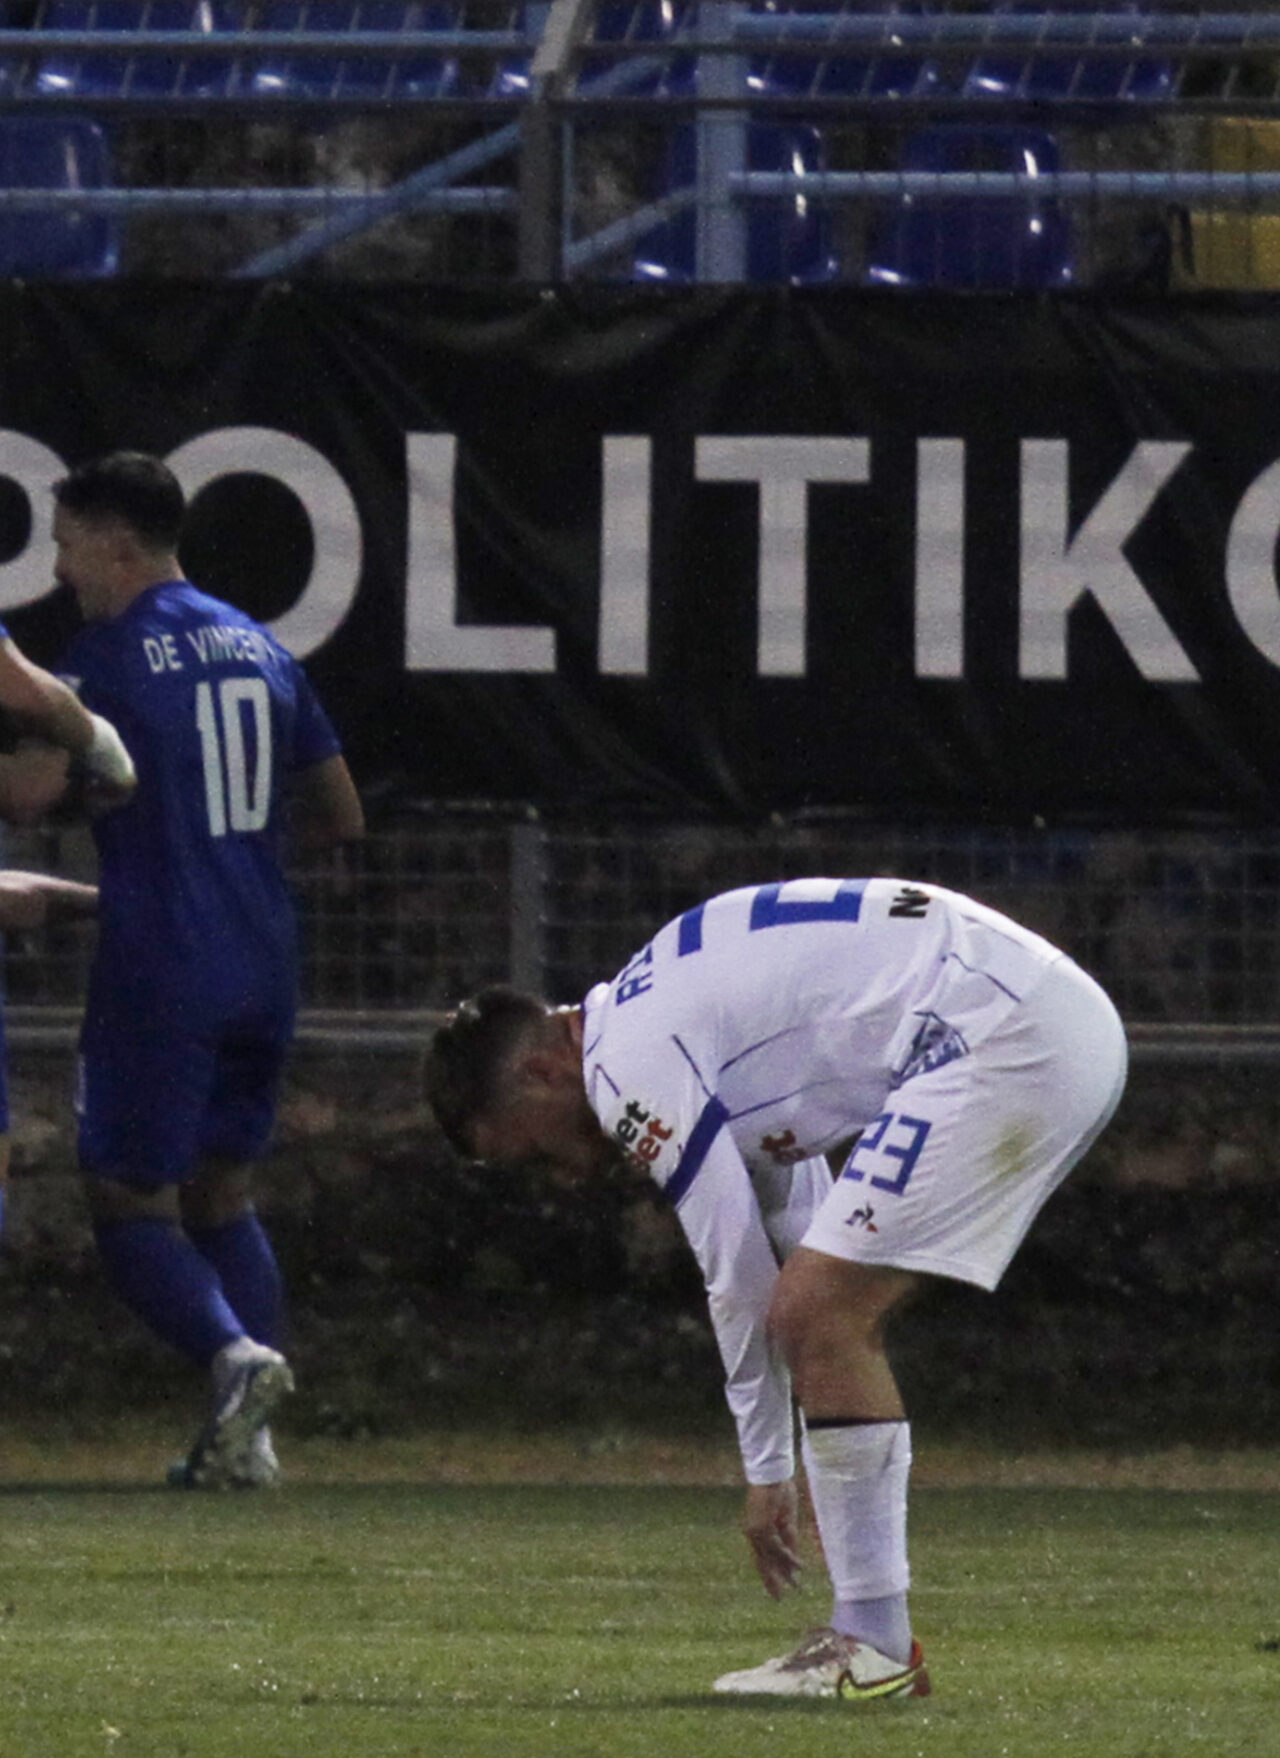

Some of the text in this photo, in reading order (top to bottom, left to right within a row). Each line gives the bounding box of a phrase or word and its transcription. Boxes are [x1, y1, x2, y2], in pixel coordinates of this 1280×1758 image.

[143, 634, 183, 674] DE
[195, 677, 273, 838] 10
[842, 1112, 932, 1197] 23
